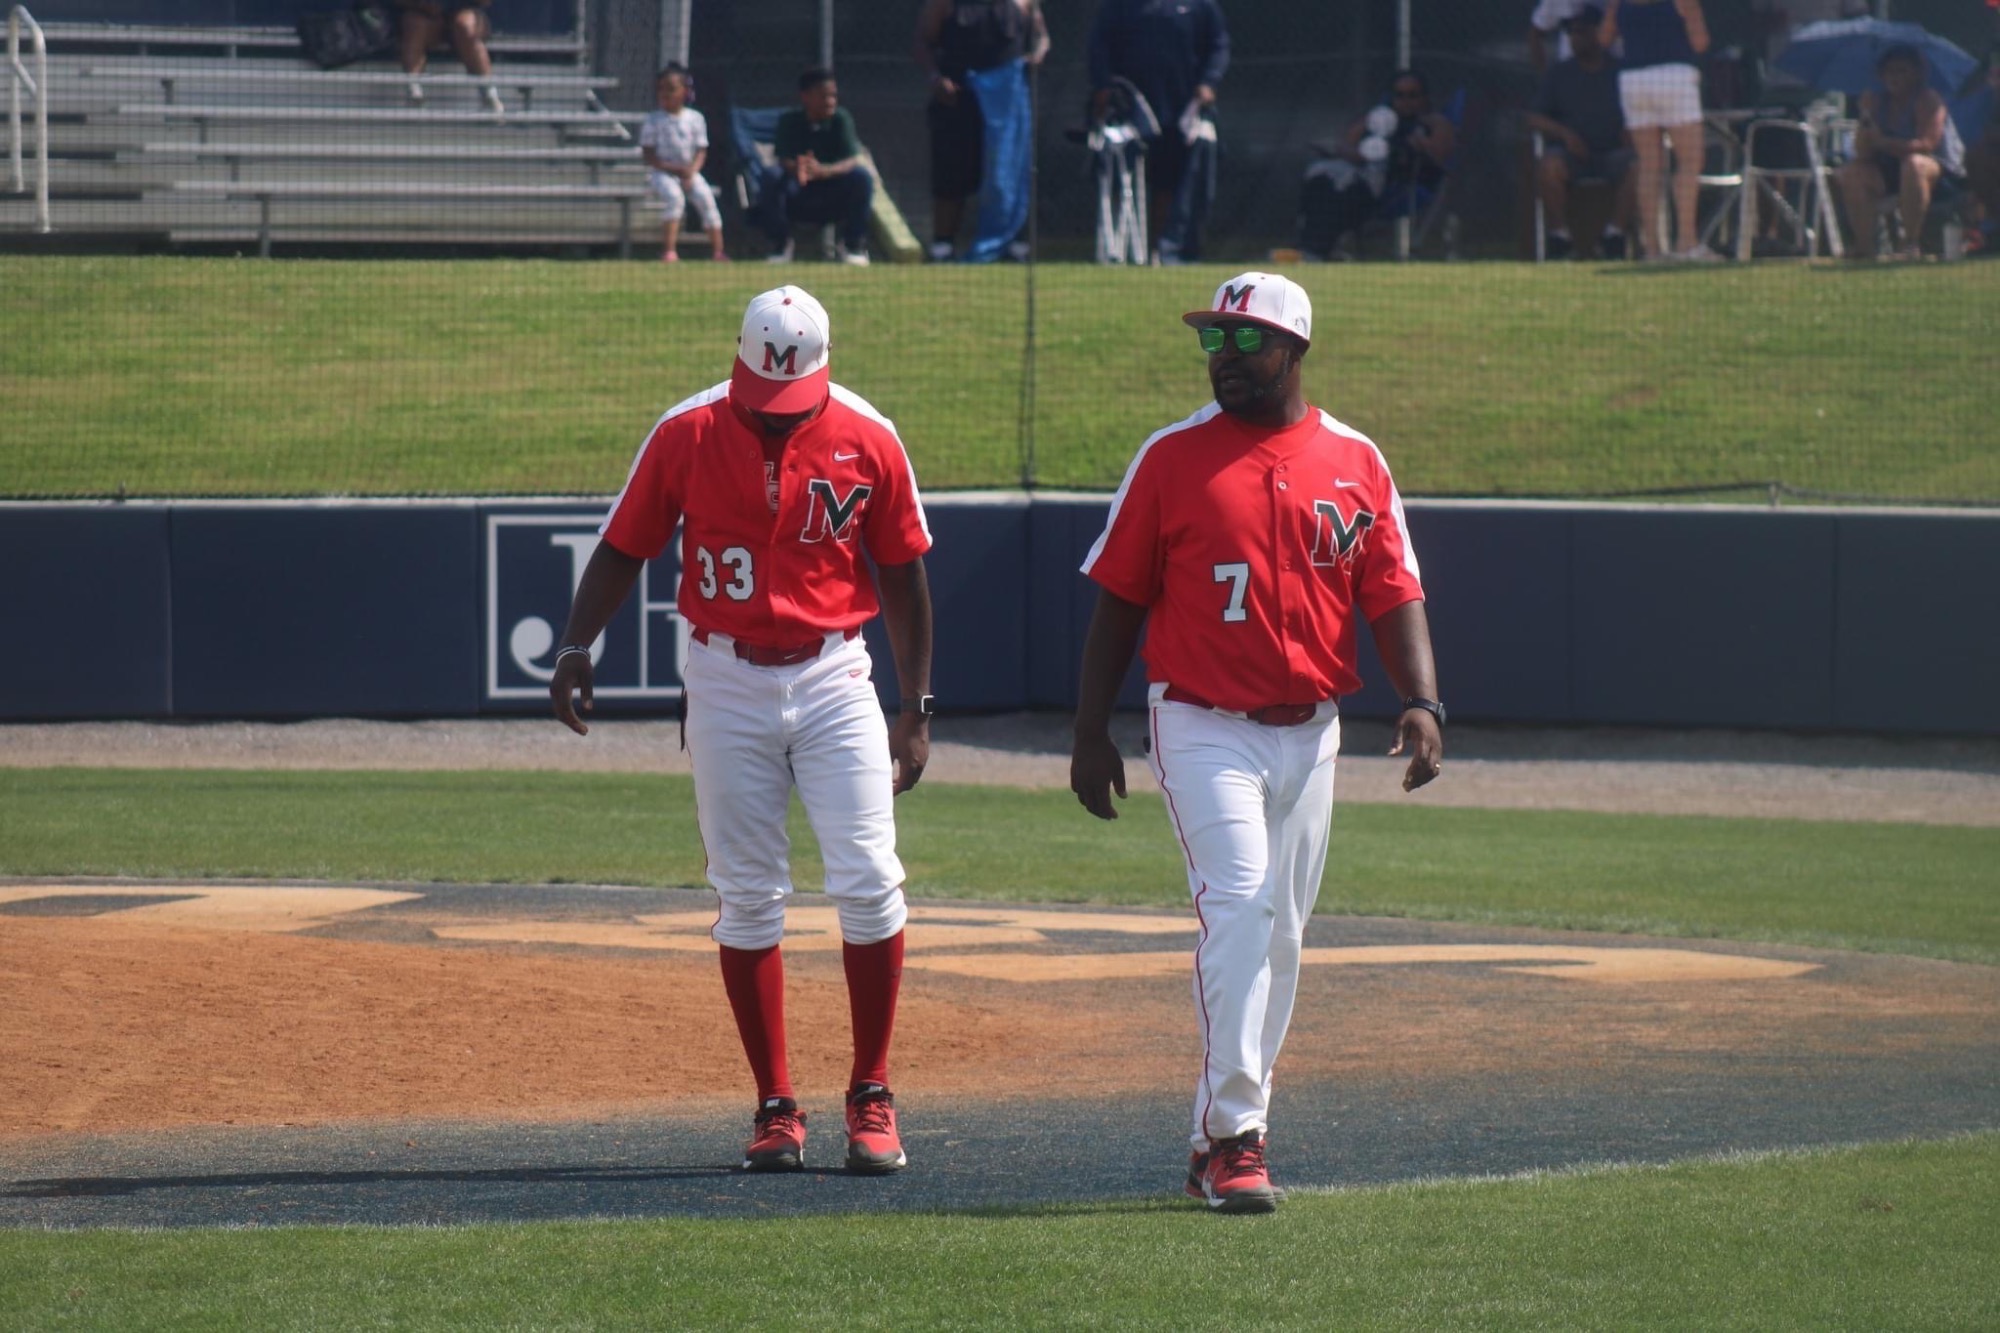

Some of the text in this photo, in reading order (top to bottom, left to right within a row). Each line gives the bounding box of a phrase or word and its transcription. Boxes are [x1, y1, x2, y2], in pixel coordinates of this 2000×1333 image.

[1218, 284, 1256, 312] M
[762, 341, 798, 375] M
[799, 478, 873, 543] M
[1311, 500, 1376, 576] M
[697, 546, 754, 601] 33
[1213, 562, 1250, 622] 7
